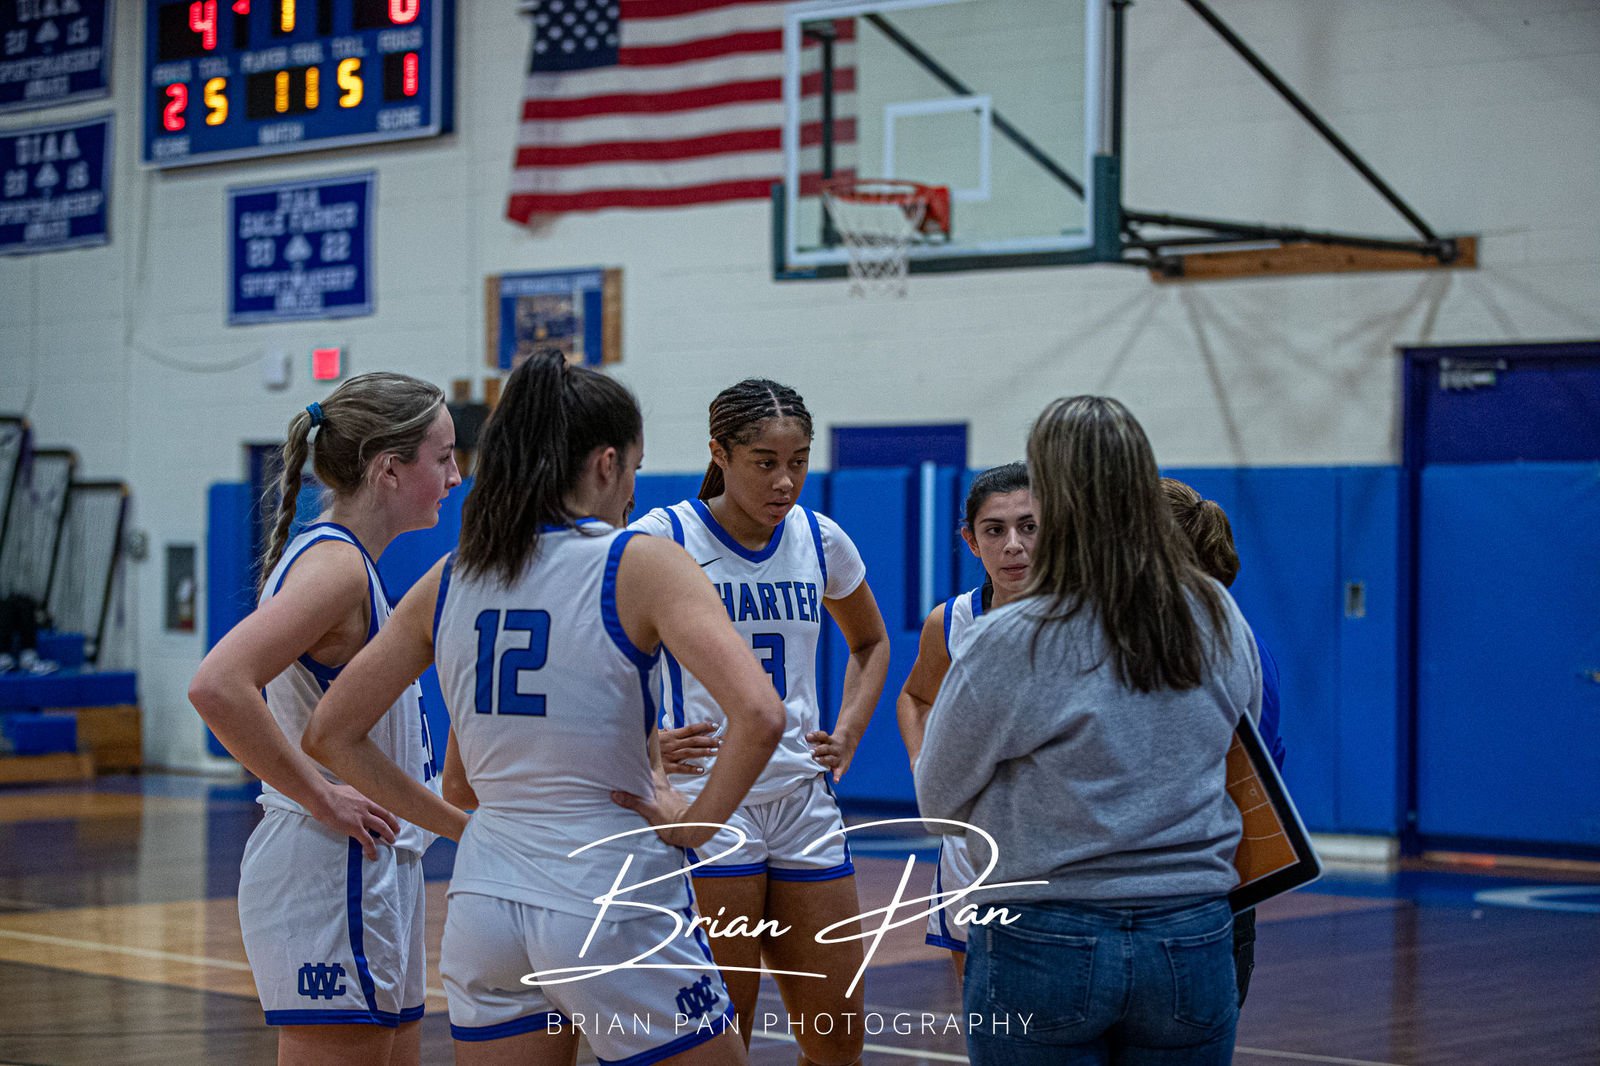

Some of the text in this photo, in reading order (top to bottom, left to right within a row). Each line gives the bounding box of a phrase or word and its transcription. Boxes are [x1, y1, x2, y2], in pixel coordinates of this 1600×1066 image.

[337, 57, 363, 108] 5
[403, 52, 418, 96] 1
[163, 83, 188, 131] 2
[204, 77, 228, 126] 5
[713, 581, 819, 623] HARTER
[474, 609, 551, 717] 12
